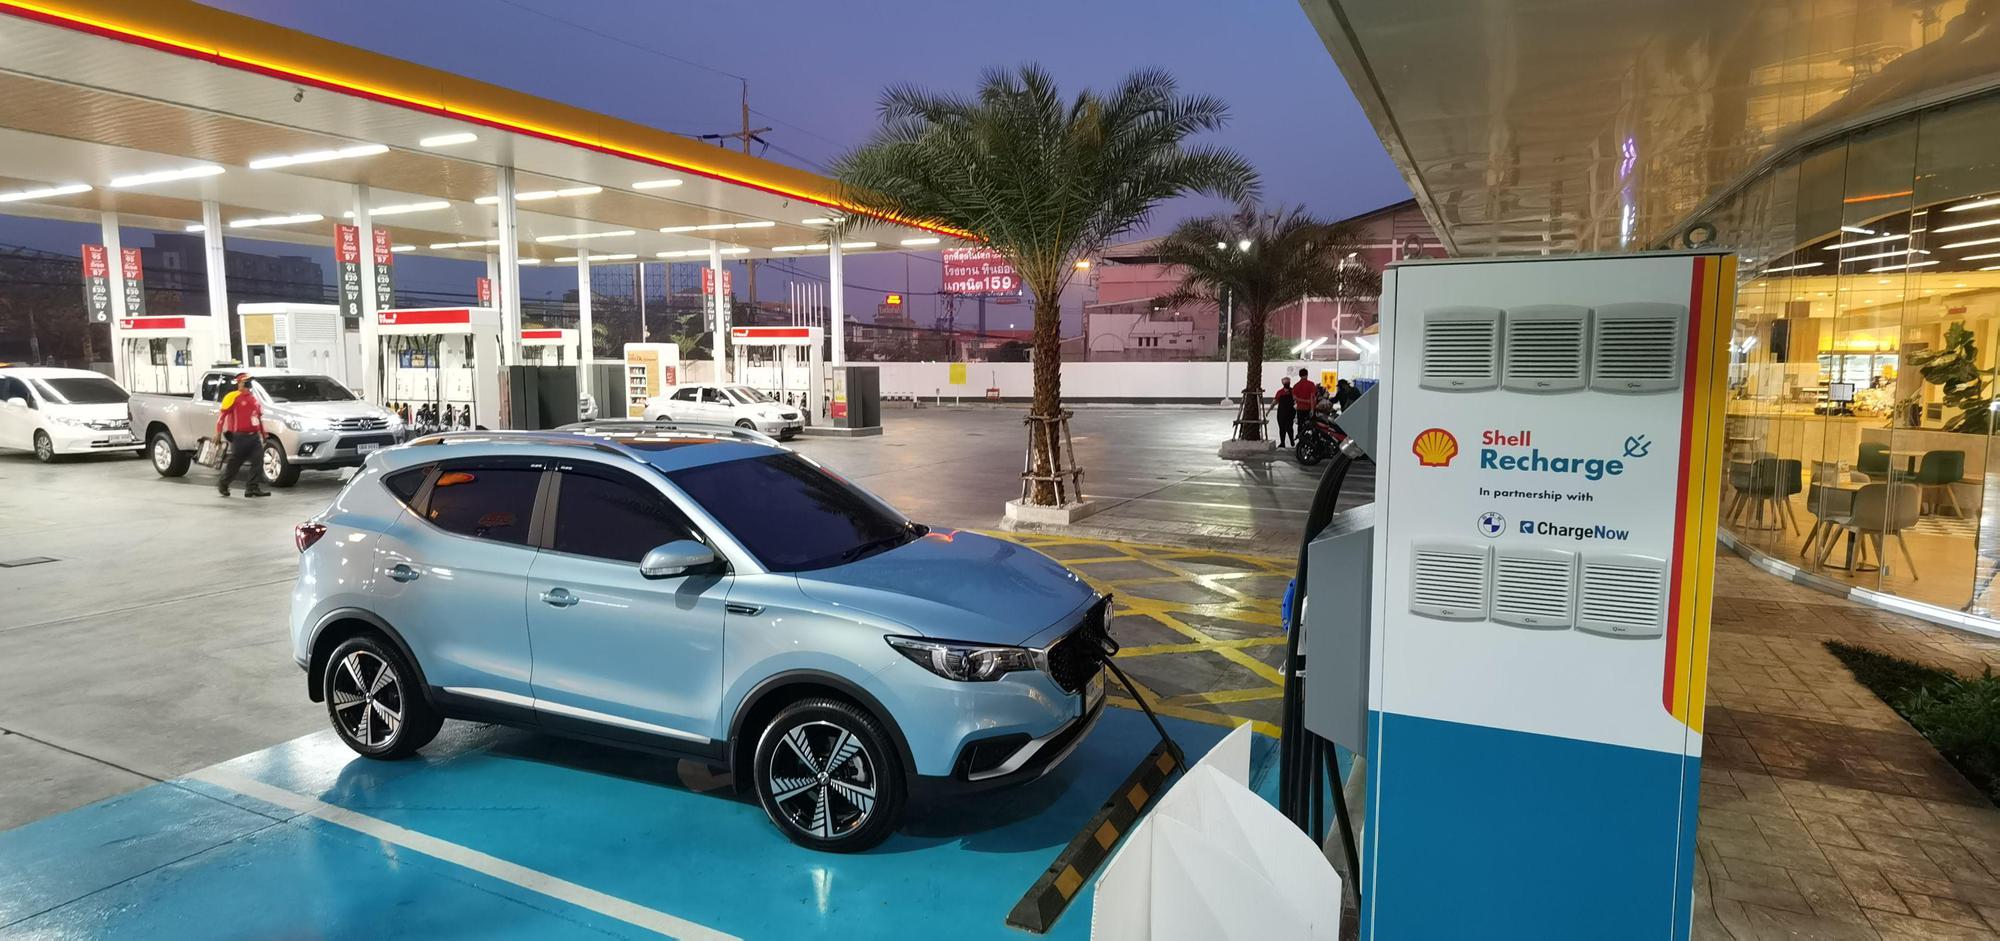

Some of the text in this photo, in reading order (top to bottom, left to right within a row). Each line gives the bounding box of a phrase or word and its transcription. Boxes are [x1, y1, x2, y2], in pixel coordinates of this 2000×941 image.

[97, 311, 106, 321] 6
[350, 303, 358, 314] 8
[1482, 430, 1531, 447] Shell
[1480, 449, 1624, 480] Recharge
[1479, 487, 1593, 502] In partnership with
[1537, 521, 1630, 540] ChargeNow
